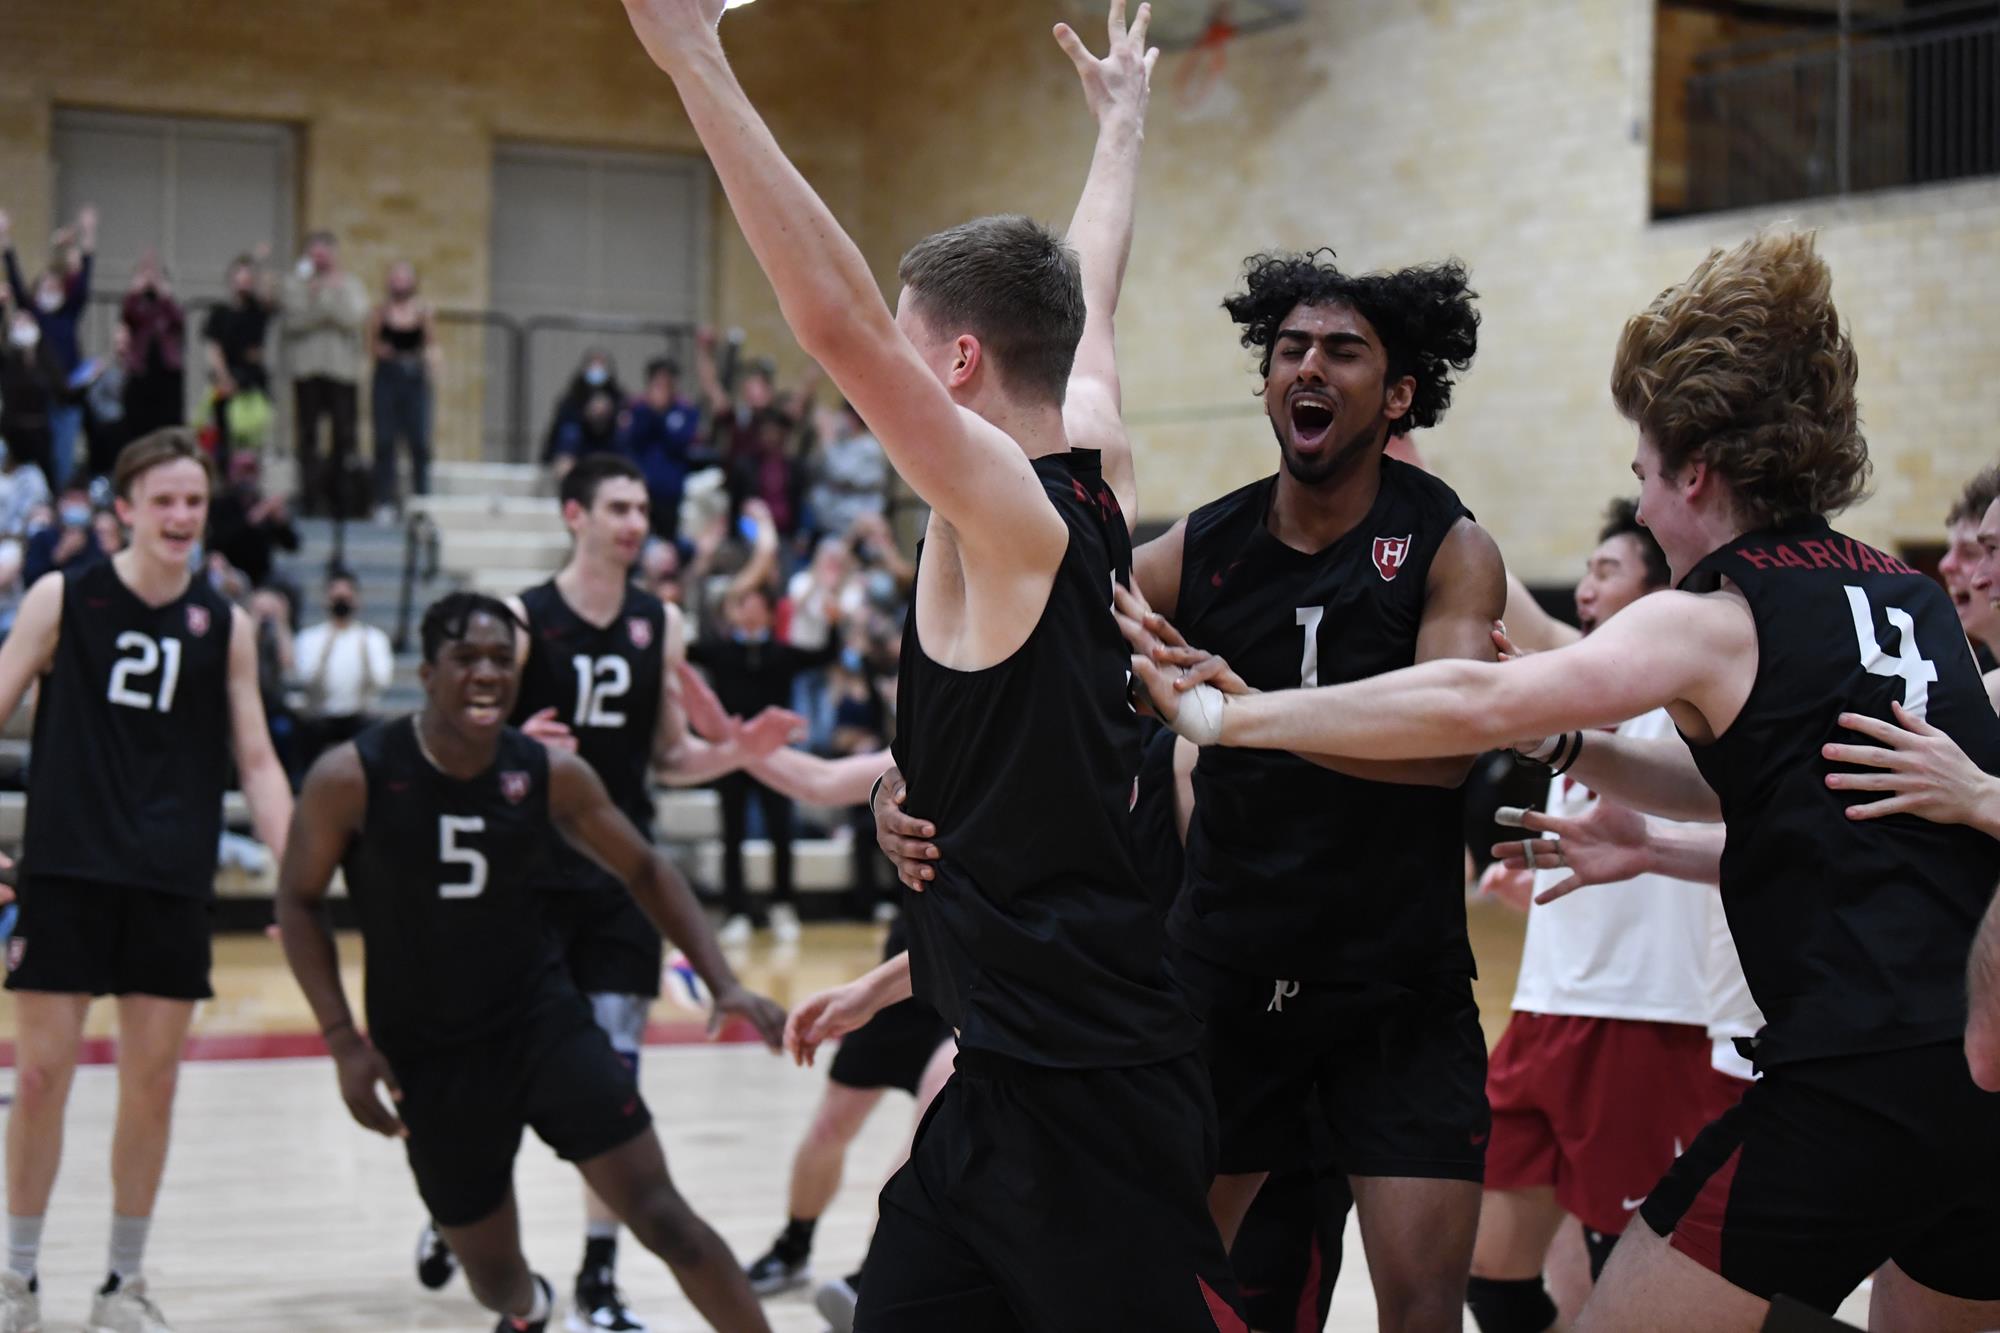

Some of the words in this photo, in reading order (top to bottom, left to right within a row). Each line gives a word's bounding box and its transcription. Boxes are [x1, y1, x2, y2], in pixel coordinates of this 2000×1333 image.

[1381, 541, 1405, 568] H
[108, 632, 181, 711] 21
[1295, 605, 1324, 689] 1
[1843, 584, 1939, 723] 4
[573, 654, 631, 726] 12
[438, 815, 487, 899] 5
